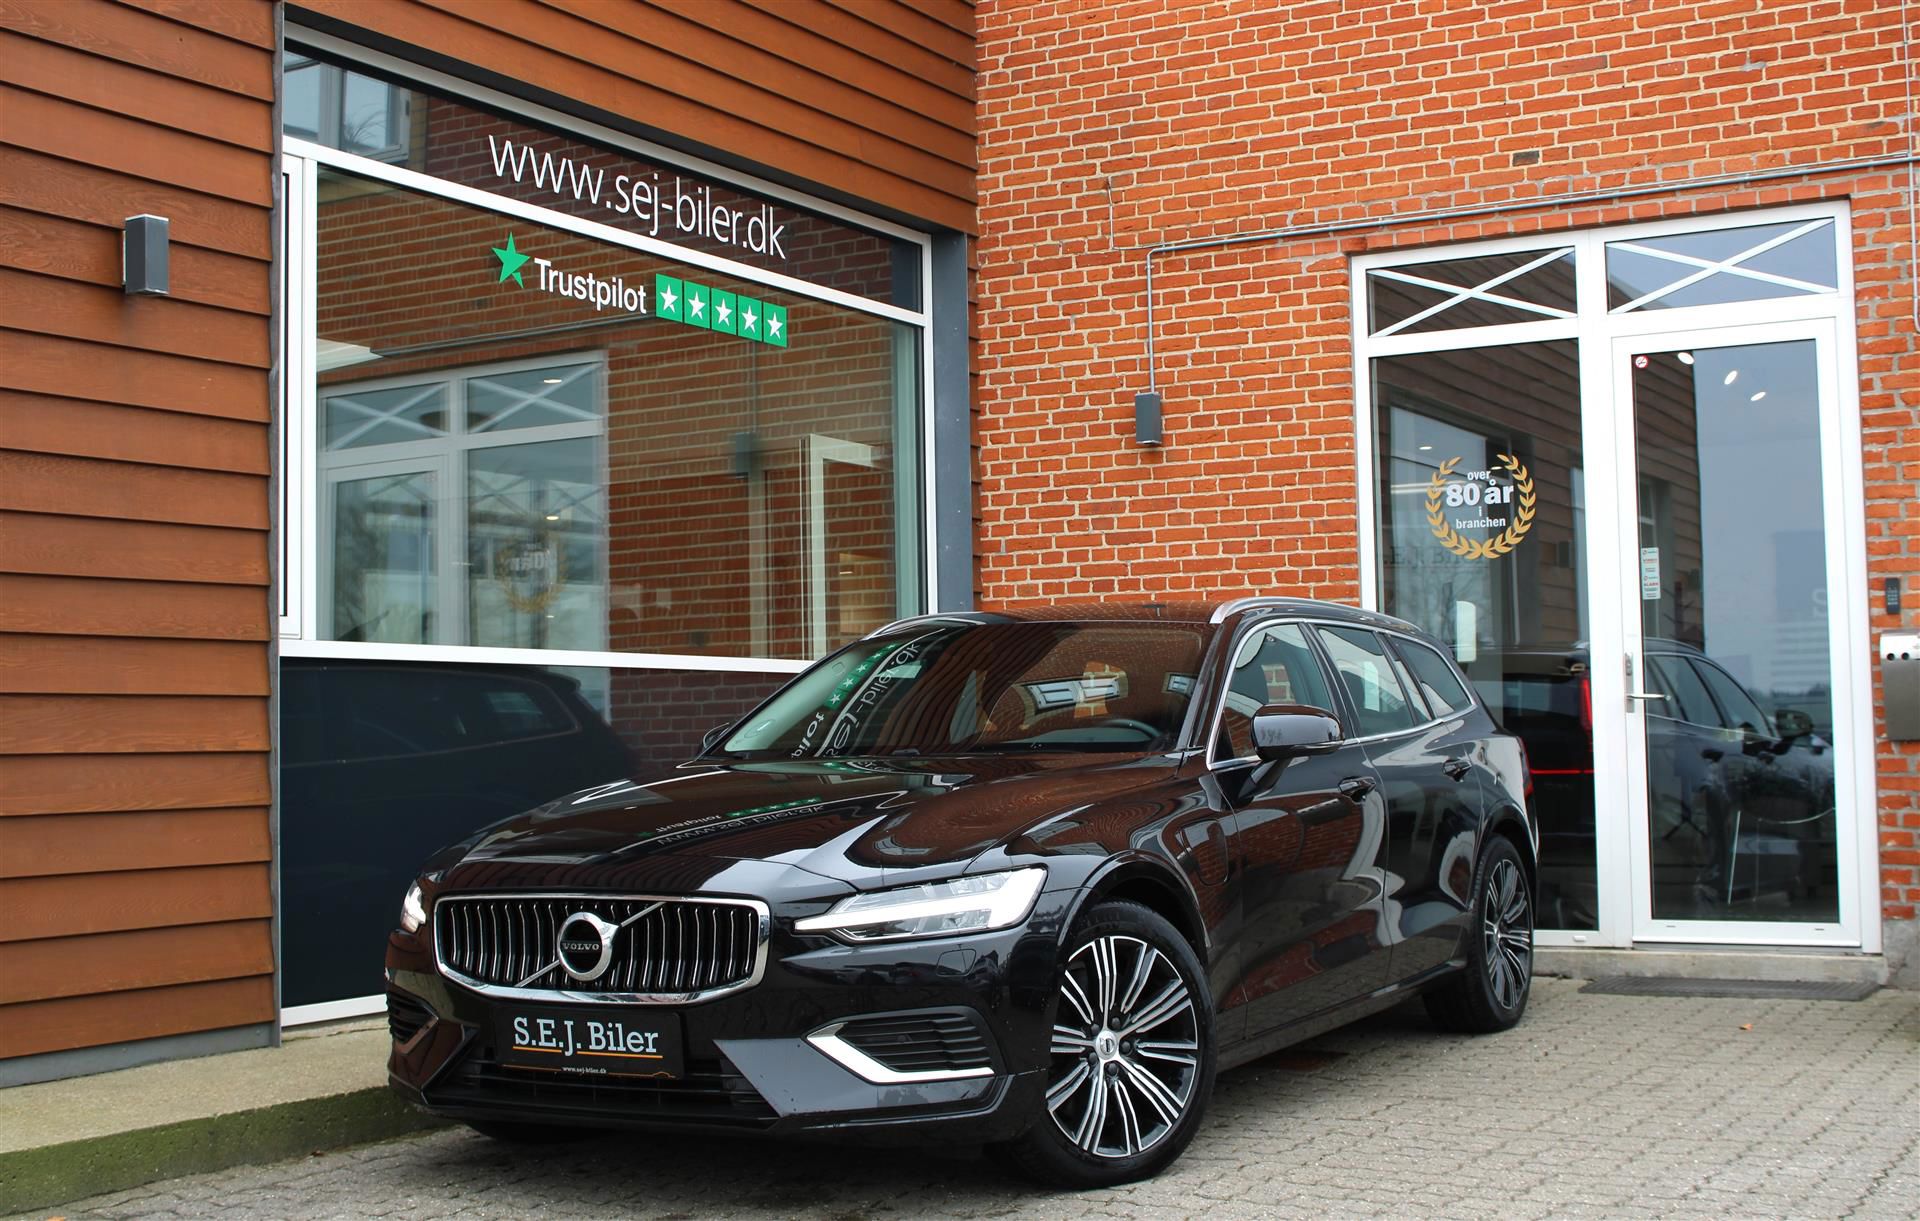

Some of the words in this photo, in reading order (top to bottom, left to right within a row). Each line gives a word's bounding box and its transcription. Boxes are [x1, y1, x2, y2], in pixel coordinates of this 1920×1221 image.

[488, 134, 786, 260] www.sej-biler.dk
[533, 257, 648, 315] Trustpilot
[1467, 470, 1491, 481] over
[1446, 482, 1481, 507] 80
[1484, 478, 1515, 505] år
[1455, 516, 1507, 530] branchen
[562, 943, 600, 951] VOLVO
[513, 1016, 582, 1056] S.E.J.
[586, 1021, 659, 1053] Biler
